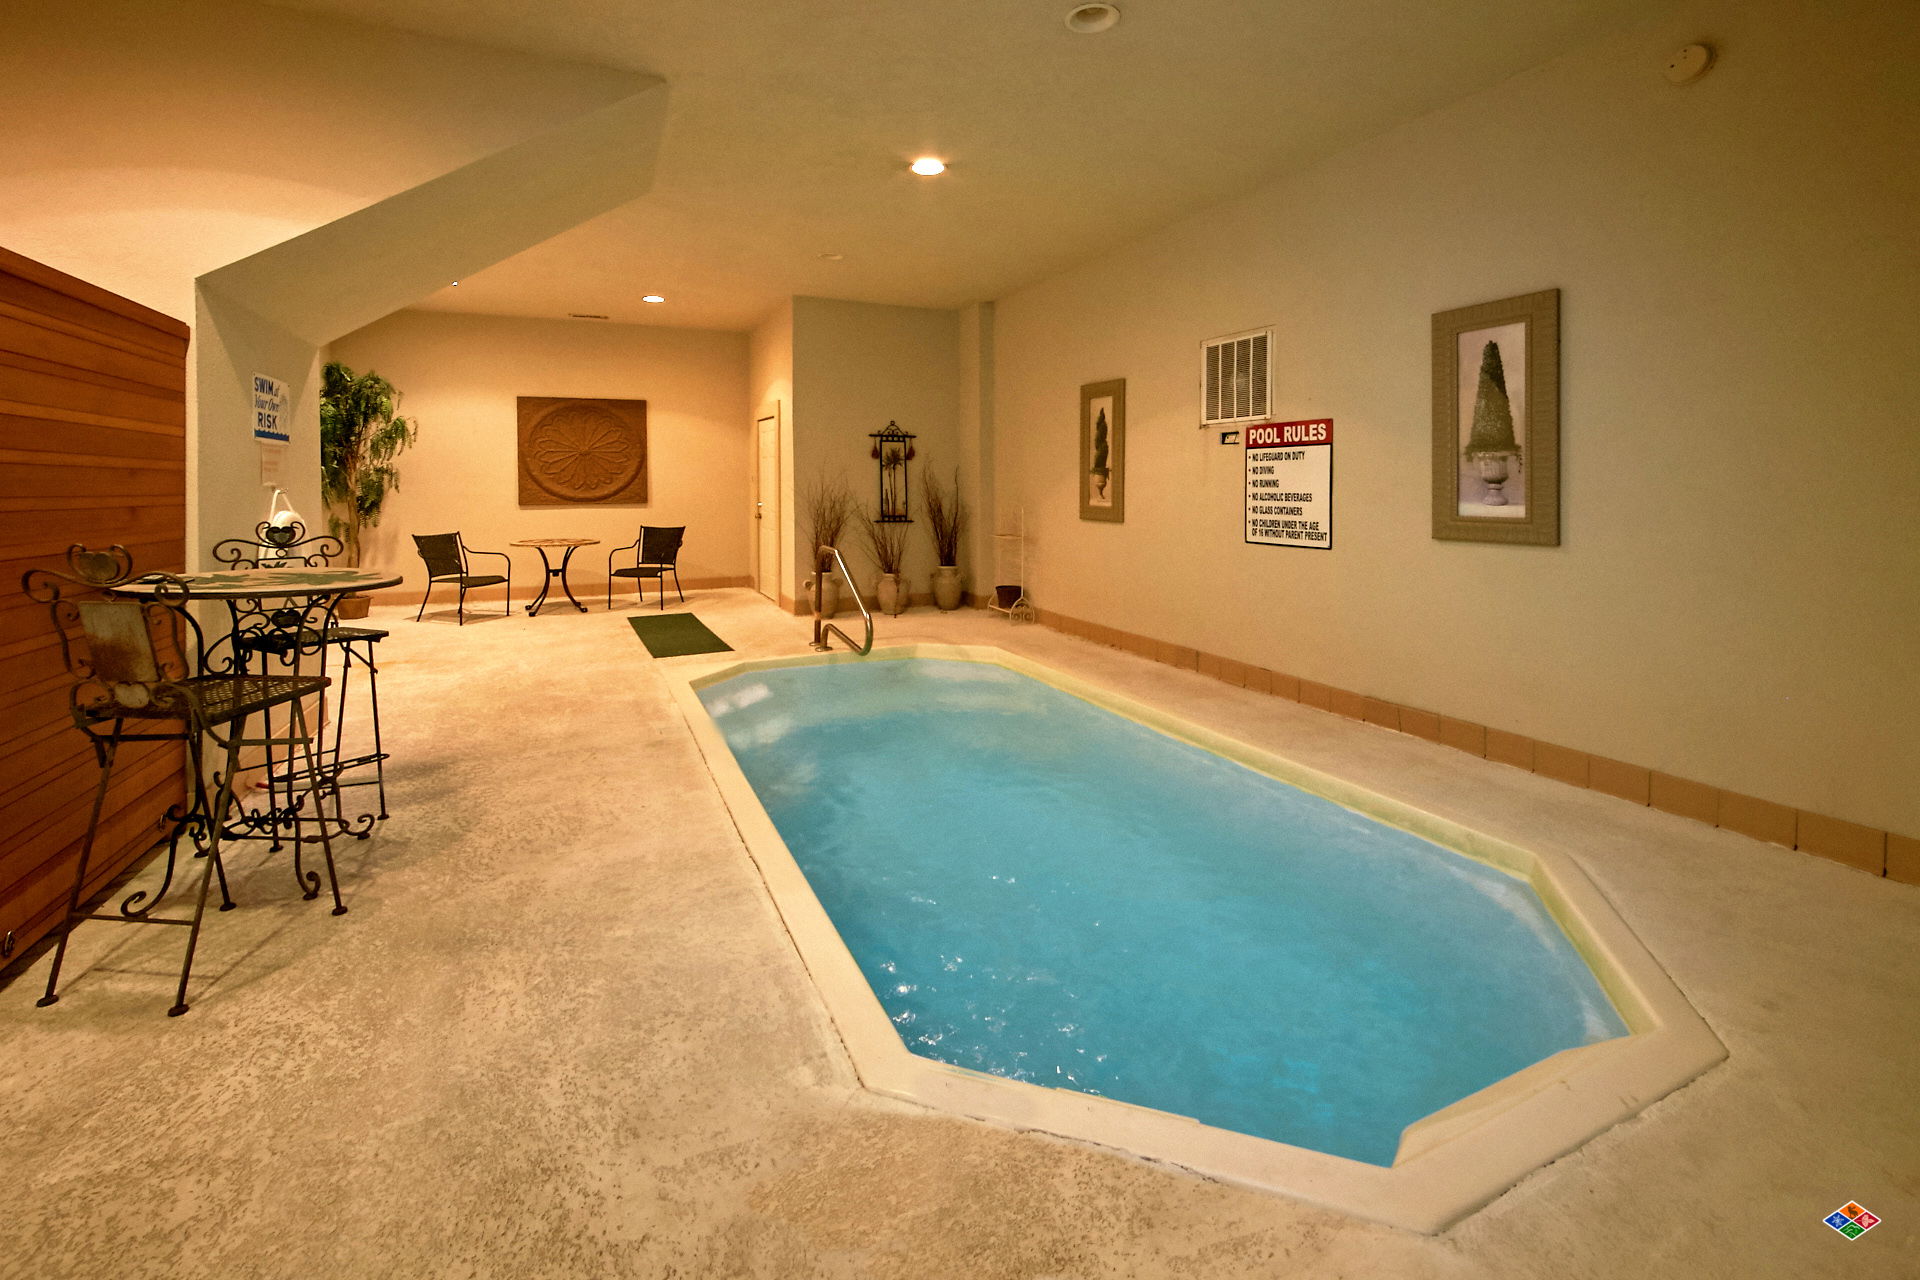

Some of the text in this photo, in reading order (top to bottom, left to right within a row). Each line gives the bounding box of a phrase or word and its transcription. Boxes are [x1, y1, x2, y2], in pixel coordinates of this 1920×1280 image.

[254, 377, 273, 395] SWIM
[255, 394, 279, 412] Your Own
[258, 412, 278, 430] RISK
[1249, 423, 1326, 444] POOL RULES
[1252, 451, 1305, 461] NO LIFEGUARD ON DUTY
[1260, 466, 1274, 474] DIVING
[1252, 480, 1279, 488] NO RUNNING
[1252, 493, 1312, 502] NO ALCOHOLIC BEVERAGES
[1252, 507, 1302, 515] NO GLASS CONTAINERS
[1252, 519, 1319, 531] NO CHILDREN UNDER THE AGE
[1252, 528, 1257, 536] OF
[1265, 529, 1284, 538] WITHOUT
[1286, 530, 1303, 539] PARENT
[1305, 531, 1327, 541] PRESENT
